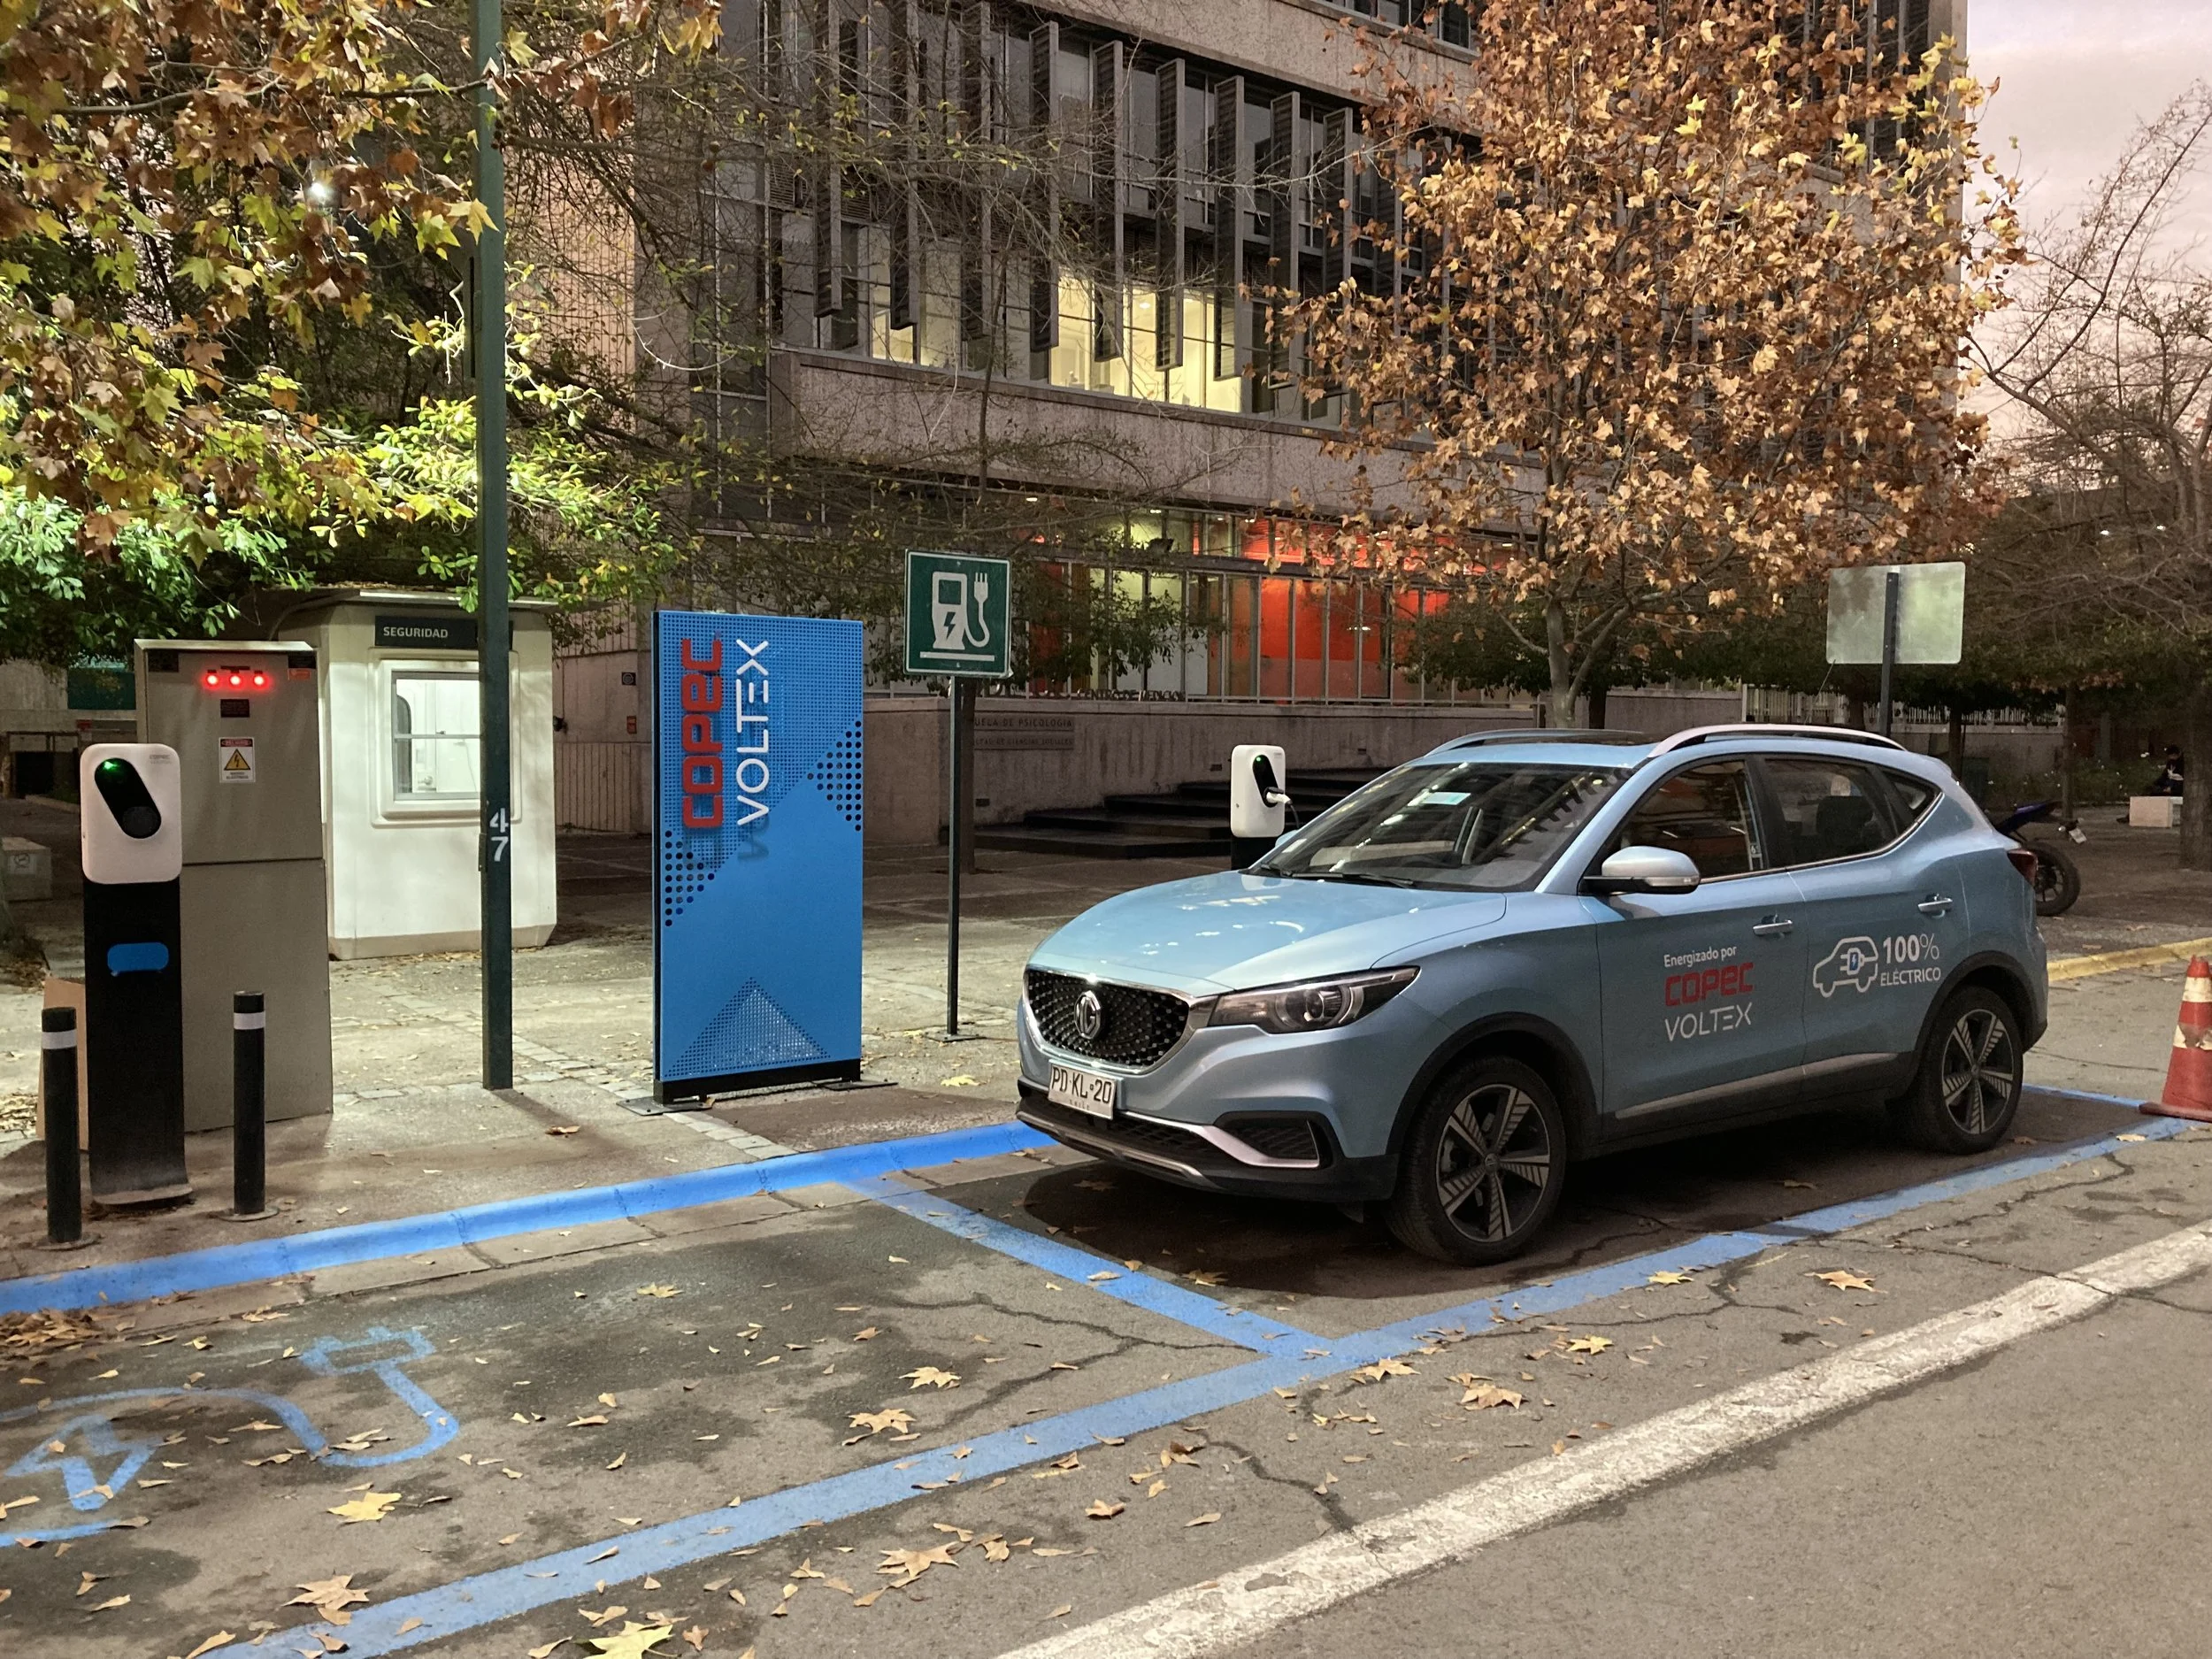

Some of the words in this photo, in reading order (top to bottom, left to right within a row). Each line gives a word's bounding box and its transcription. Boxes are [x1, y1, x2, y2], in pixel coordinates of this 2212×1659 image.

[383, 626, 449, 638] SEGURIDAD
[681, 638, 724, 828] COPEC
[736, 639, 769, 826] VOLTEX
[975, 718, 998, 727] UELA
[1002, 718, 1014, 727] DE
[1663, 946, 1719, 968] Energizado
[1720, 946, 1737, 962] por
[1883, 933, 1940, 964] 100%
[1665, 963, 1755, 1006] COPEC
[1880, 967, 1941, 987] ELÉCTRICO
[1664, 1002, 1753, 1041] VOLTEX
